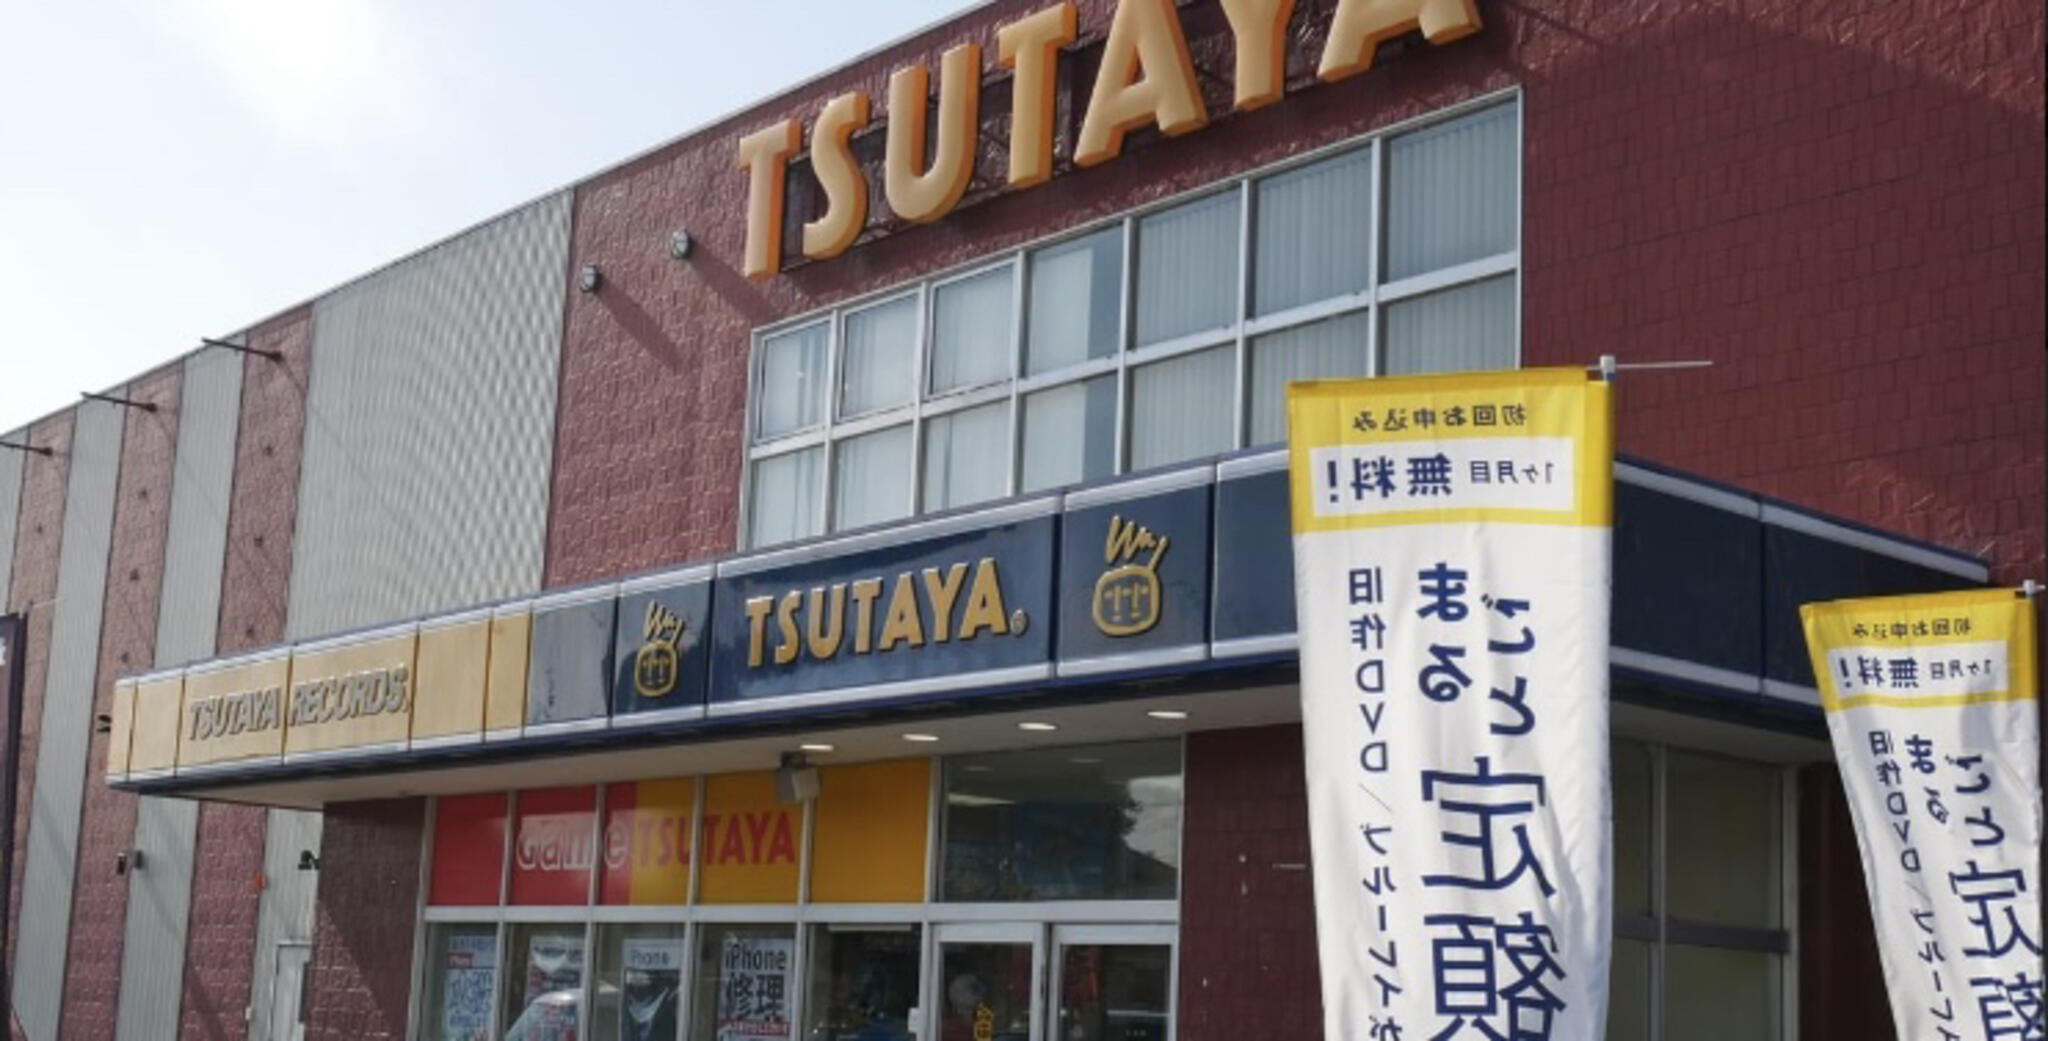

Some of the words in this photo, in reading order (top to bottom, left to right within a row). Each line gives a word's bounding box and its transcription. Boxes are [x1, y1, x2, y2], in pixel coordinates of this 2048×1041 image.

[746, 557, 1008, 668] TSUTAYA
[189, 686, 281, 741] TSUTAYA
[637, 811, 796, 866] TSUTAYA
[725, 943, 788, 970] iPhone
[725, 971, 786, 1022] 修理
